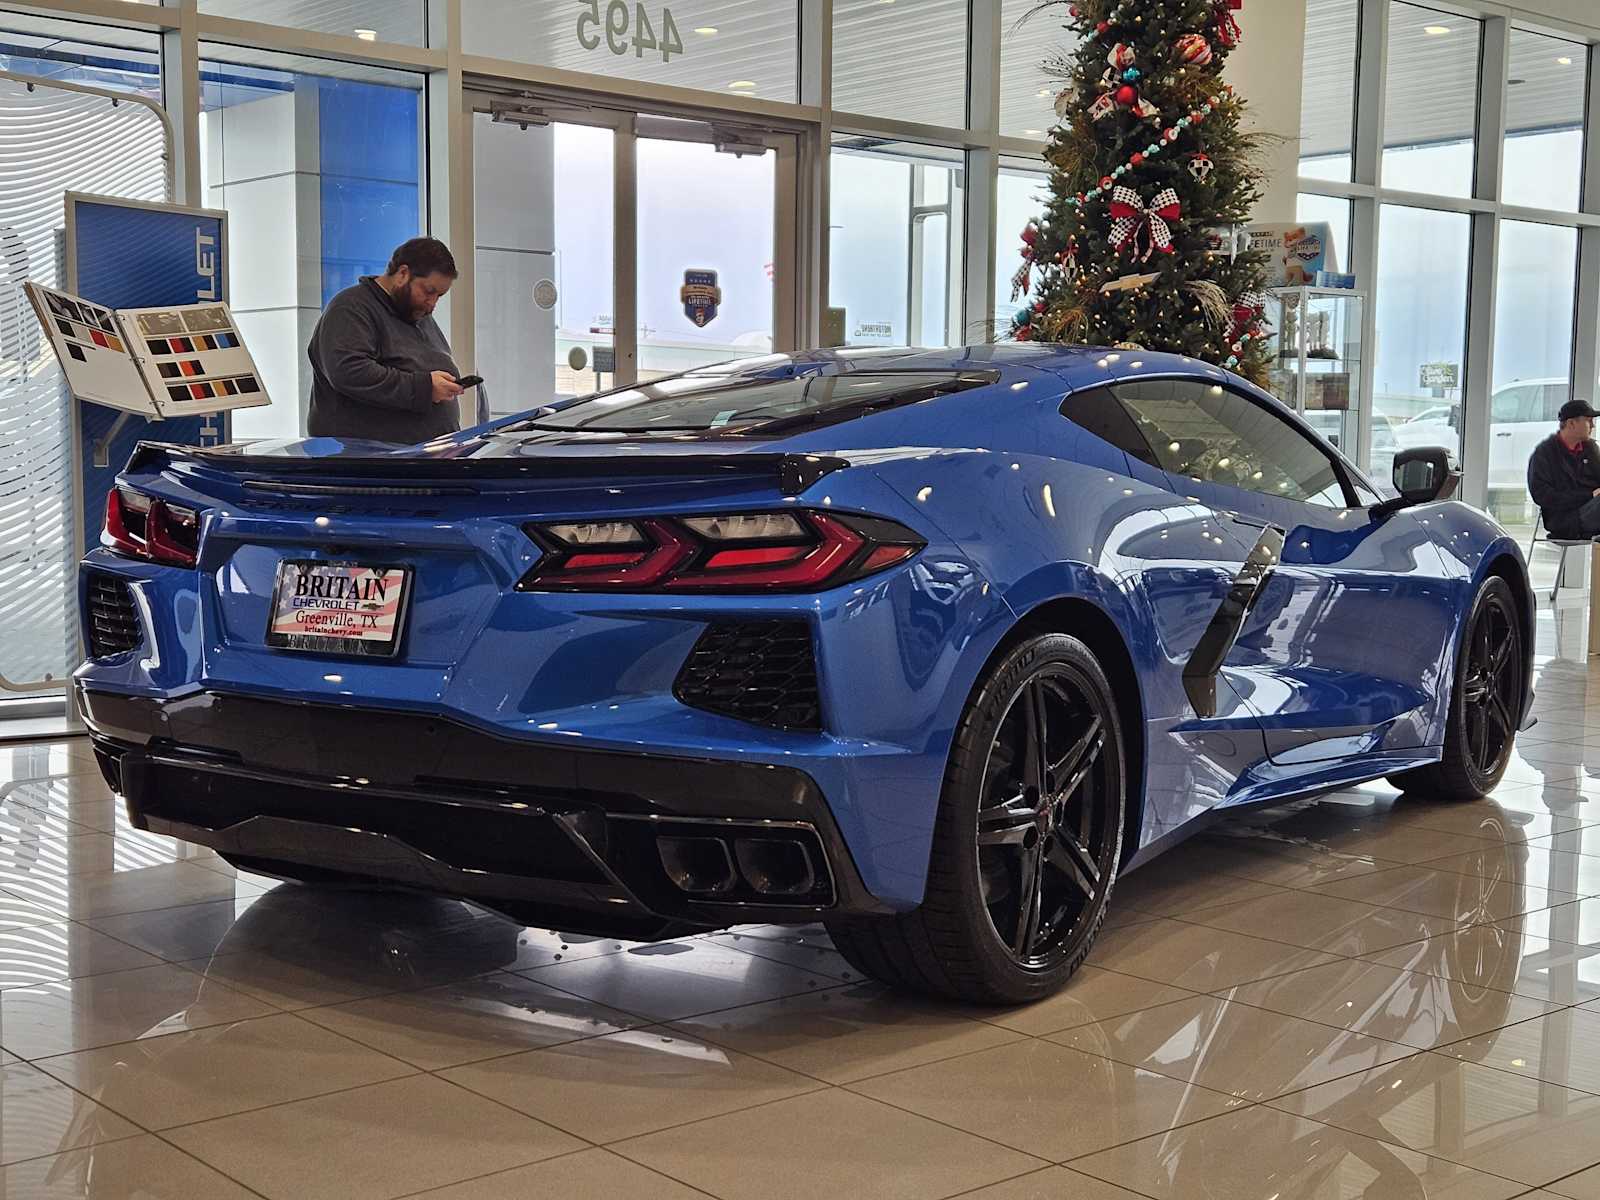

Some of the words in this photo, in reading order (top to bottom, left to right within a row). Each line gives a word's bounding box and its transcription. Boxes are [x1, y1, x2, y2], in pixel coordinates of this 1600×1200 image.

[294, 574, 389, 601] BRITAIN
[292, 597, 360, 611] CHEVROLET
[296, 610, 356, 628] Greenville,
[361, 614, 379, 629] TX
[304, 626, 363, 636] britainchevy.com
